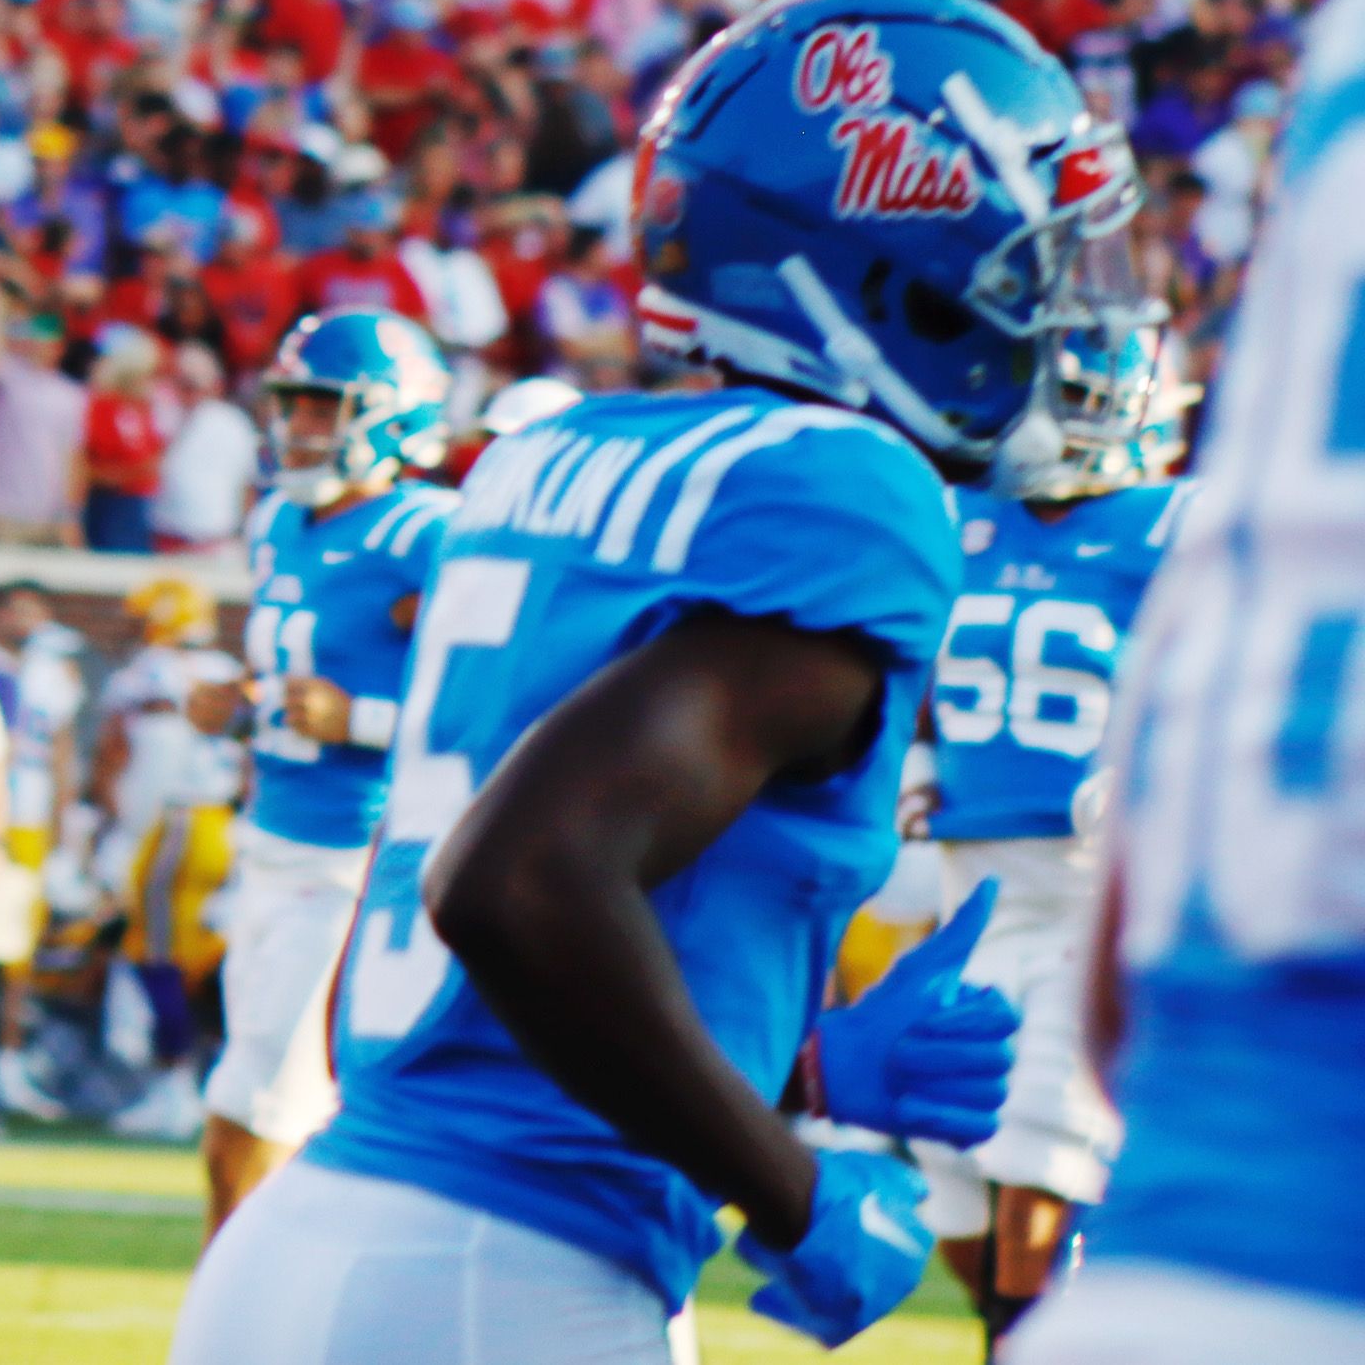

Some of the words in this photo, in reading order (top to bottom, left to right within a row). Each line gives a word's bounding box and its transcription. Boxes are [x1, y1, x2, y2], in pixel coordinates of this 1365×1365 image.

[794, 24, 894, 115] Ole
[829, 111, 977, 219] Miss
[934, 594, 1115, 759] 56
